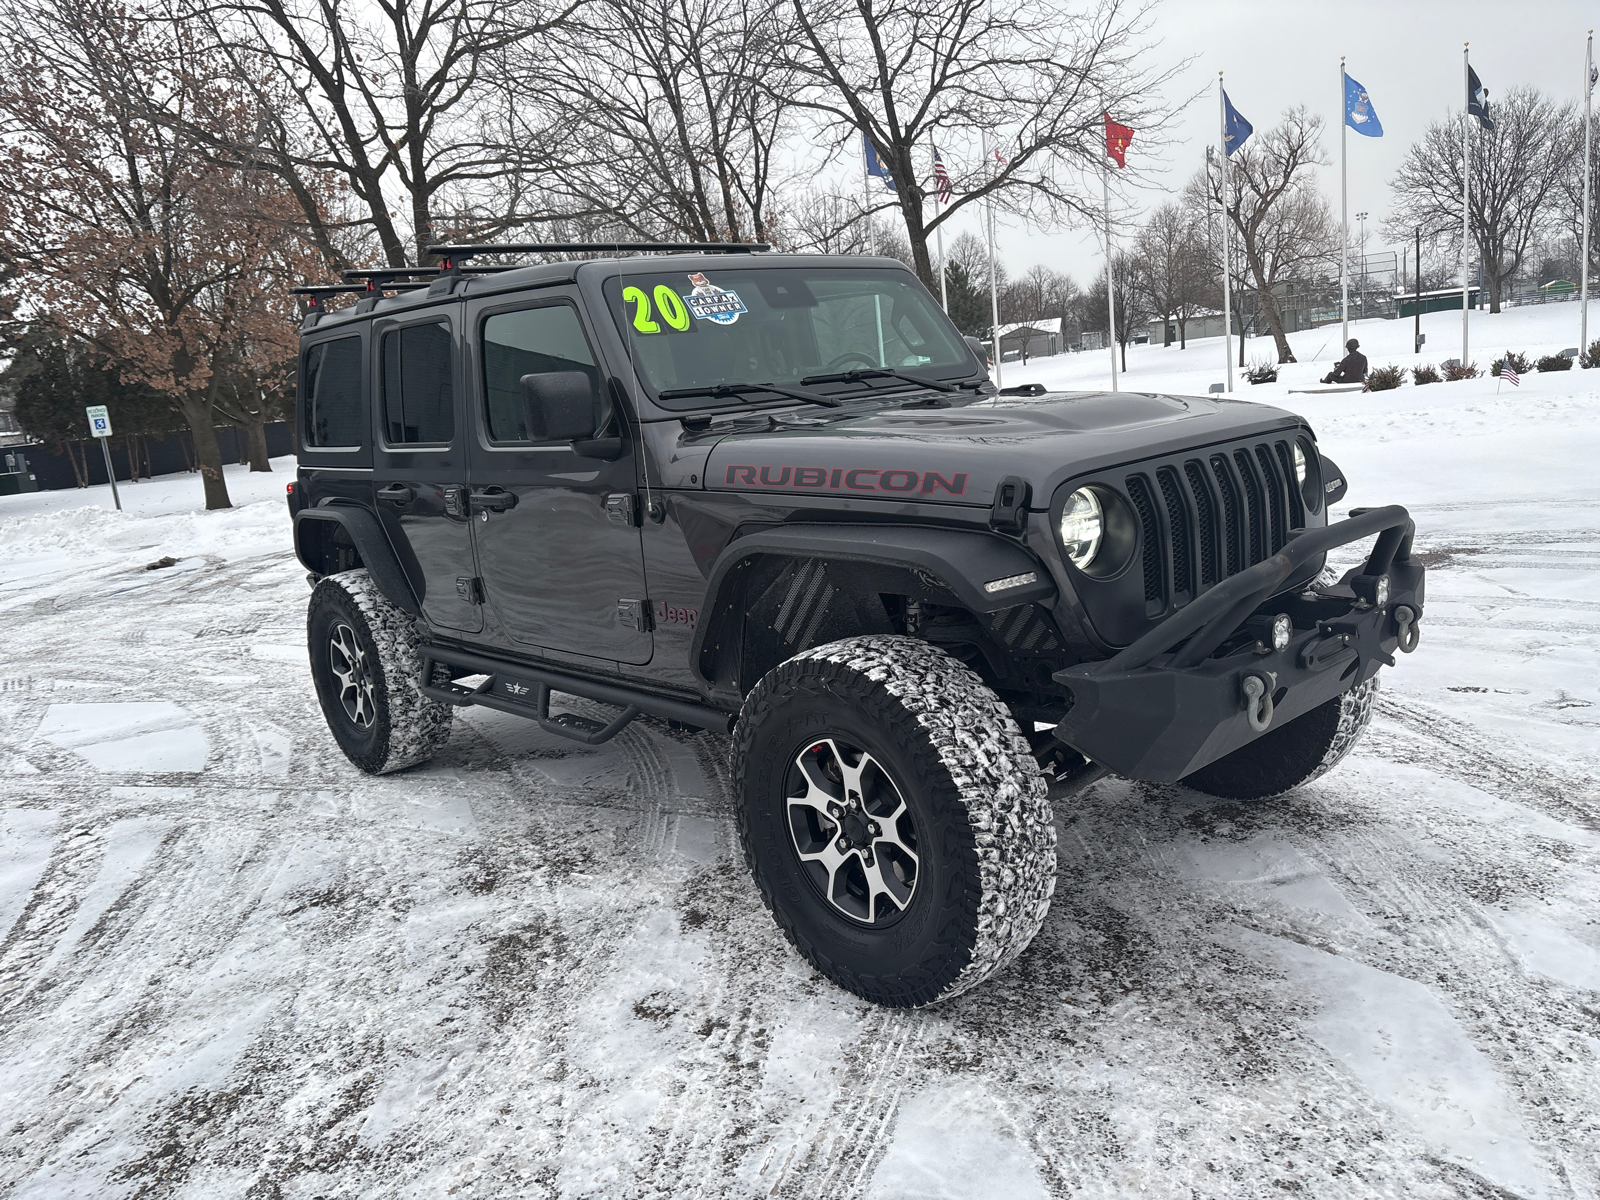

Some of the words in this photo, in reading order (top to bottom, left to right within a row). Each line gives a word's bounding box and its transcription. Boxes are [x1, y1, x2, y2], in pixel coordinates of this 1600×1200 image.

[622, 284, 690, 334] 20
[690, 295, 738, 306] CARFAX
[703, 303, 742, 314] OWNER
[724, 464, 969, 496] RUBICON
[656, 601, 698, 629] Jeep
